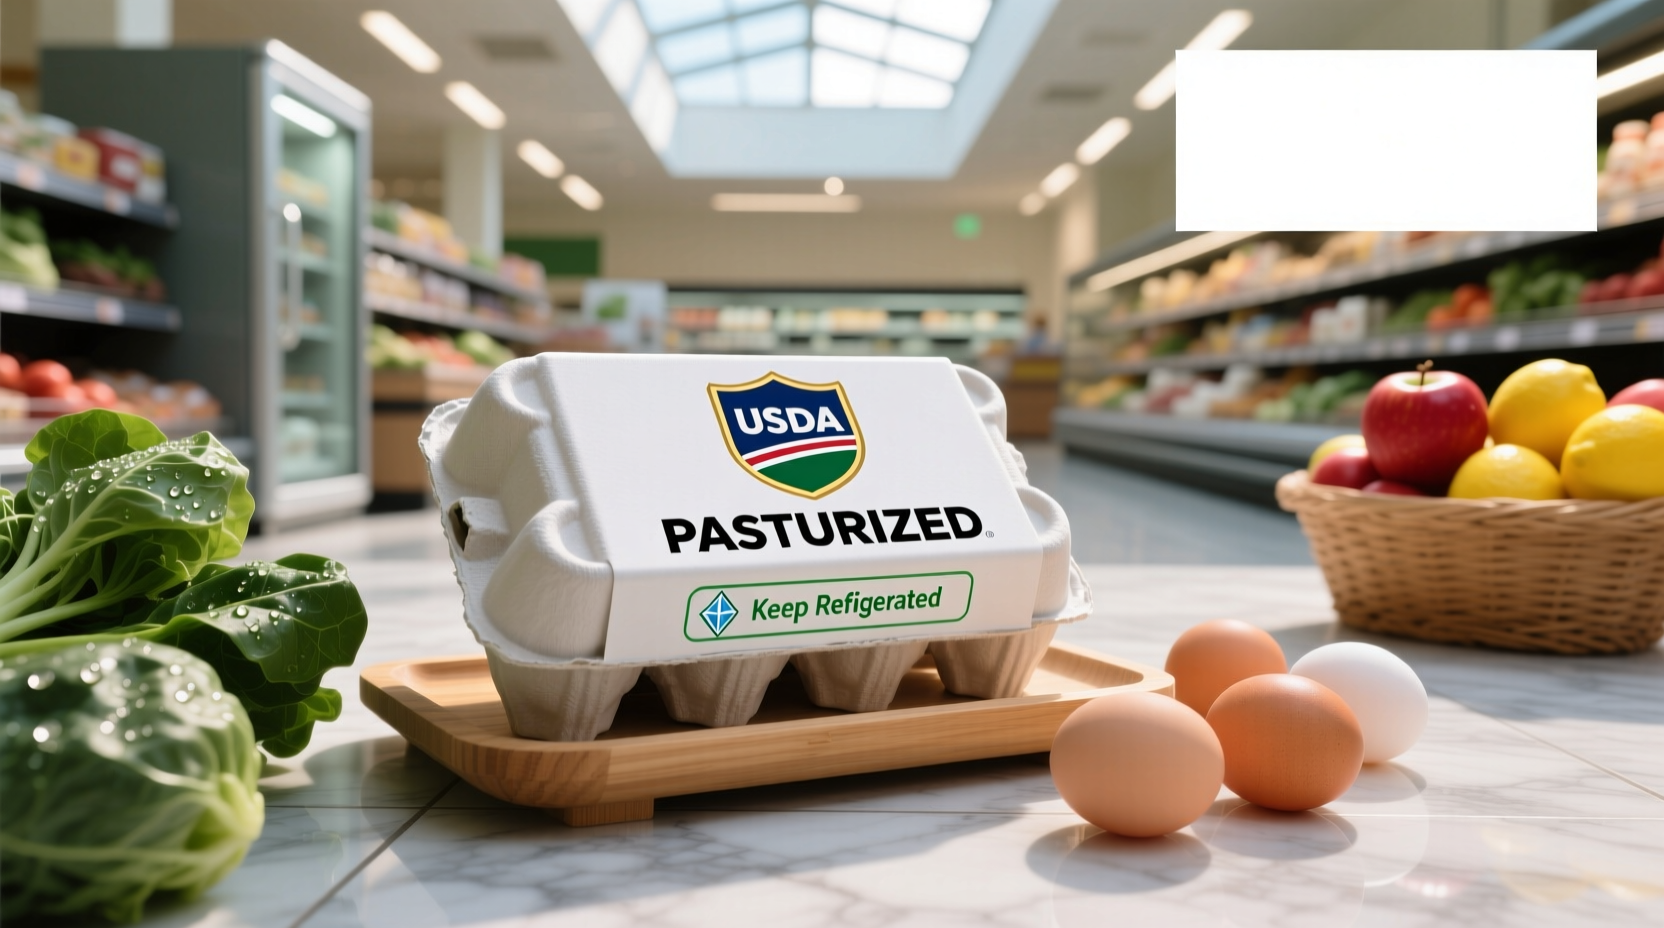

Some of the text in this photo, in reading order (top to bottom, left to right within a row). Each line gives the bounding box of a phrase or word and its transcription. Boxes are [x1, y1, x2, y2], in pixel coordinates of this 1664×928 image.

[734, 406, 845, 435] USDA
[661, 506, 983, 553] PASTURIZED
[751, 586, 943, 624] Keep Refigerated
